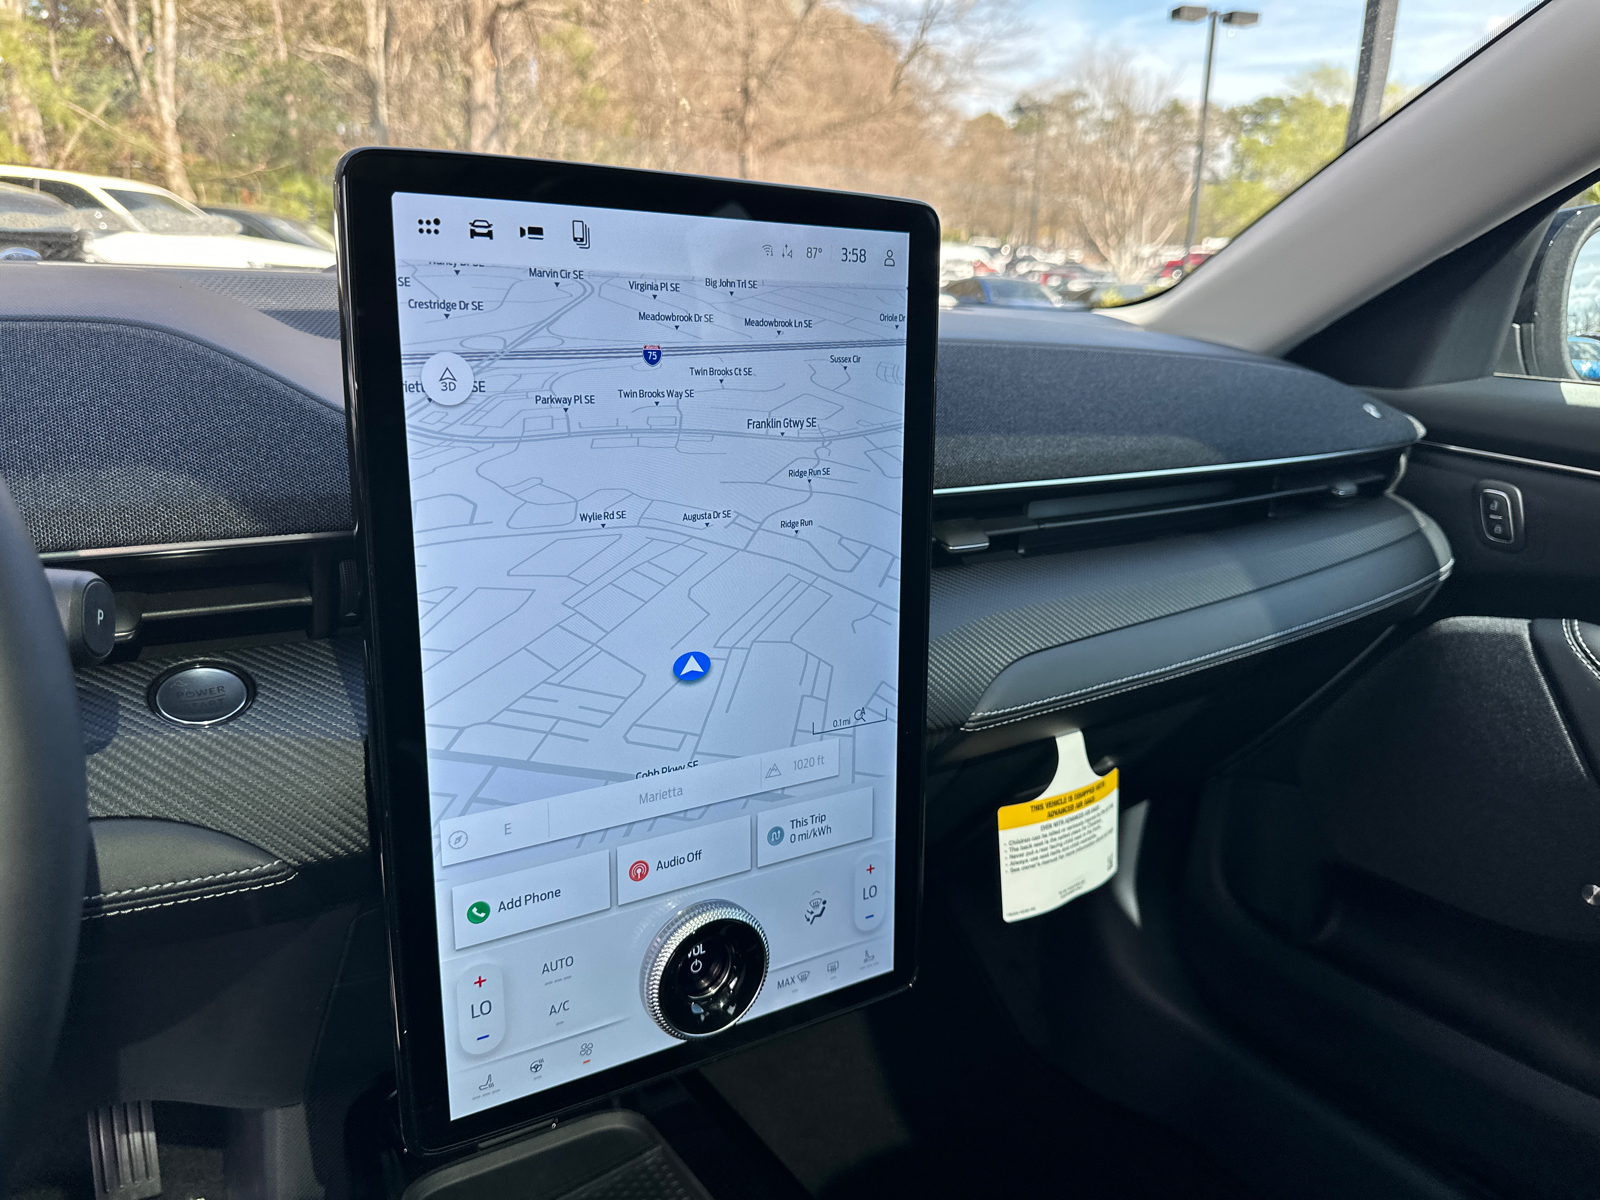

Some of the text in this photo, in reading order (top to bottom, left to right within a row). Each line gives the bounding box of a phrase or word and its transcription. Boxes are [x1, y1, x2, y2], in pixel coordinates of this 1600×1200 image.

[841, 248, 866, 264] 3:58
[529, 267, 584, 280] Marvin Cir SE
[398, 276, 410, 287] SE
[628, 281, 680, 293] Virginia Pl SE
[705, 278, 758, 290] Big John Trl SE
[408, 299, 484, 312] Crestridge Dr SE
[638, 311, 714, 323] Meadowbrook Dr SE
[744, 318, 813, 328] Meadowbrook Ln SE
[880, 314, 898, 322] Oriole
[647, 351, 657, 360] 75
[830, 354, 861, 364] Sussex Cir
[690, 366, 752, 376] Twin Brooks Ct SE
[440, 381, 456, 392] 3D
[535, 395, 595, 406] Parkway Pl SE
[618, 389, 694, 400] Twin Brooks Way SE
[747, 417, 817, 429] Franklin Gtwy SE
[788, 468, 830, 478] Ridge Run SE
[580, 511, 627, 522] Wylie Rd SE
[683, 510, 732, 522] Augusta Dr SE
[780, 519, 813, 529] Ridge Run
[97, 609, 104, 625] P
[176, 685, 226, 698] POWER
[833, 717, 851, 727] 0.1 mi
[793, 755, 824, 771] 1020 ft
[639, 786, 683, 804] Marietta
[790, 813, 826, 829] This Trip
[504, 823, 512, 835] E
[790, 825, 832, 843] 0 mi/kWh
[656, 850, 702, 871] Audio Off
[863, 885, 877, 900] LO
[498, 888, 561, 912] Add Phone
[542, 956, 574, 975] AUTO
[777, 975, 796, 989] MAX
[471, 1000, 492, 1019] LO
[549, 1000, 570, 1016] A/C
